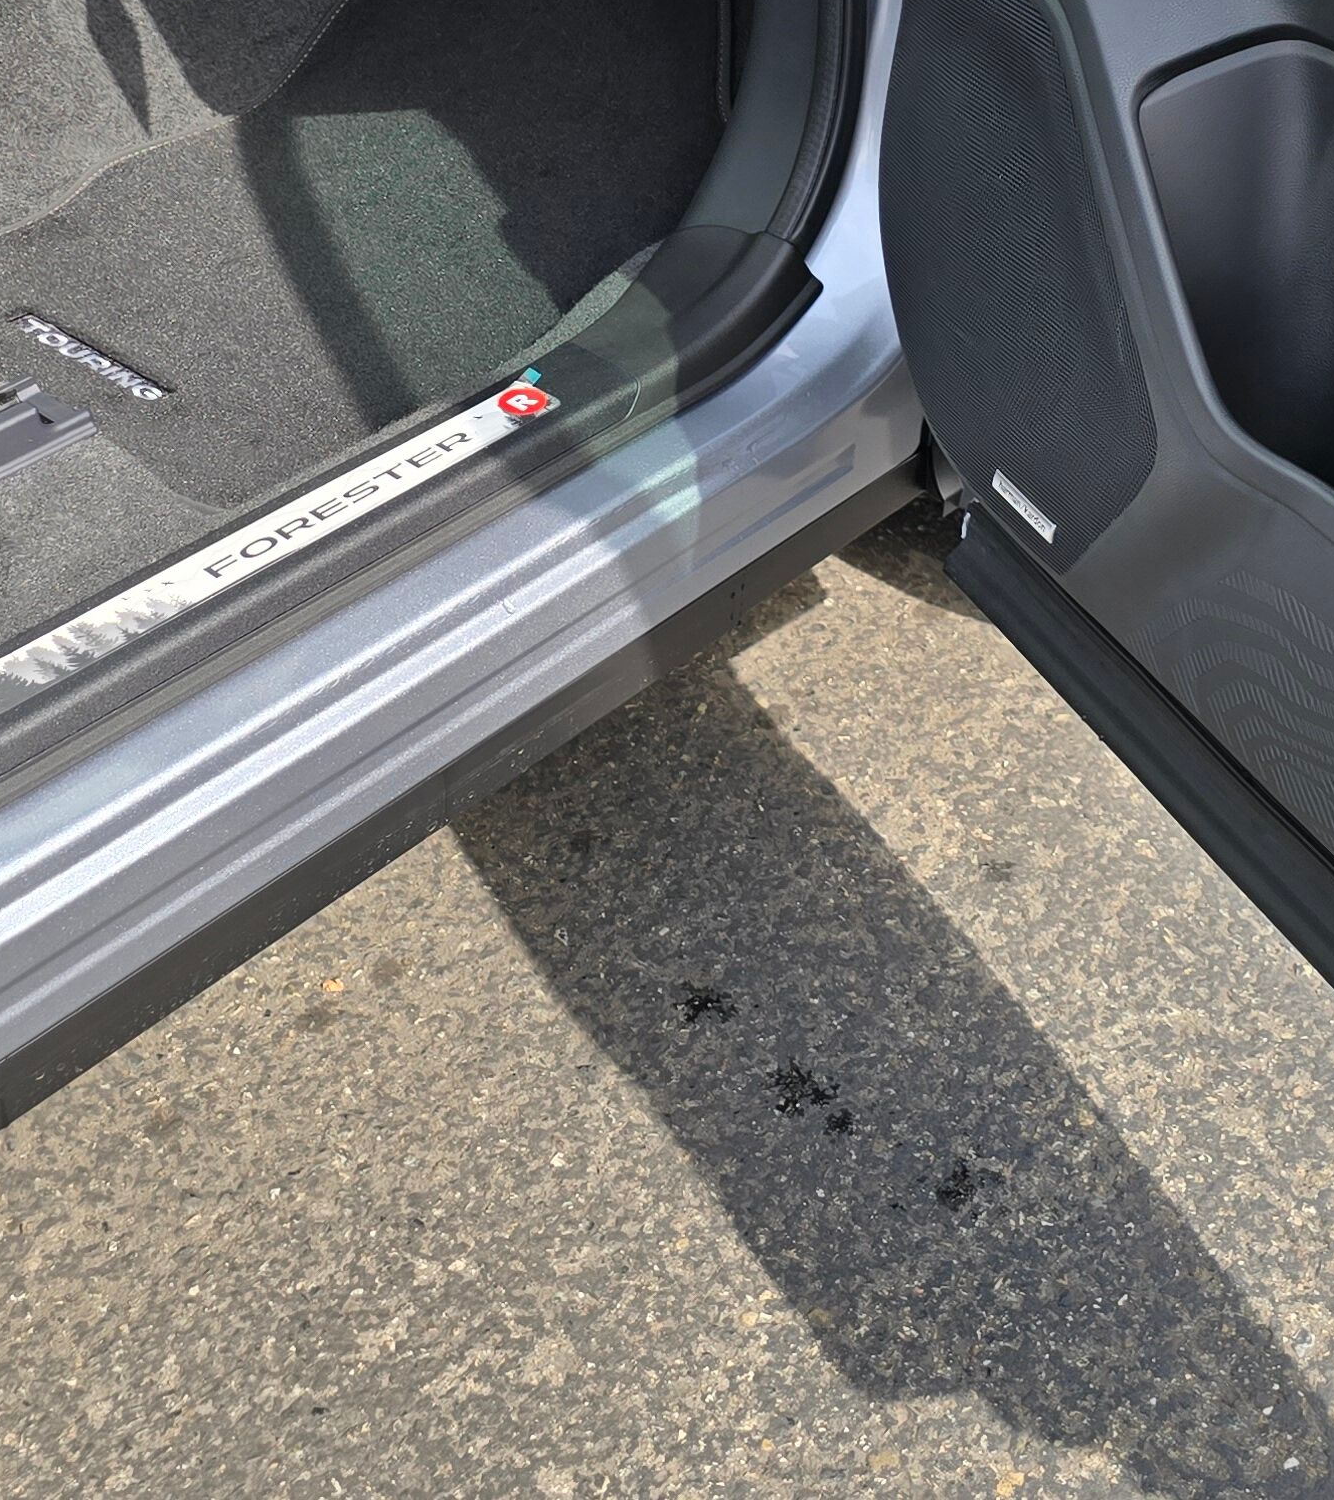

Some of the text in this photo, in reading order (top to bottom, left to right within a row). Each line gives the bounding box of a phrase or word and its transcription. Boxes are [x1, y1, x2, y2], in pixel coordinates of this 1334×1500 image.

[17, 318, 165, 401] TOURING
[506, 393, 539, 411] R
[203, 431, 473, 579] FORESTER
